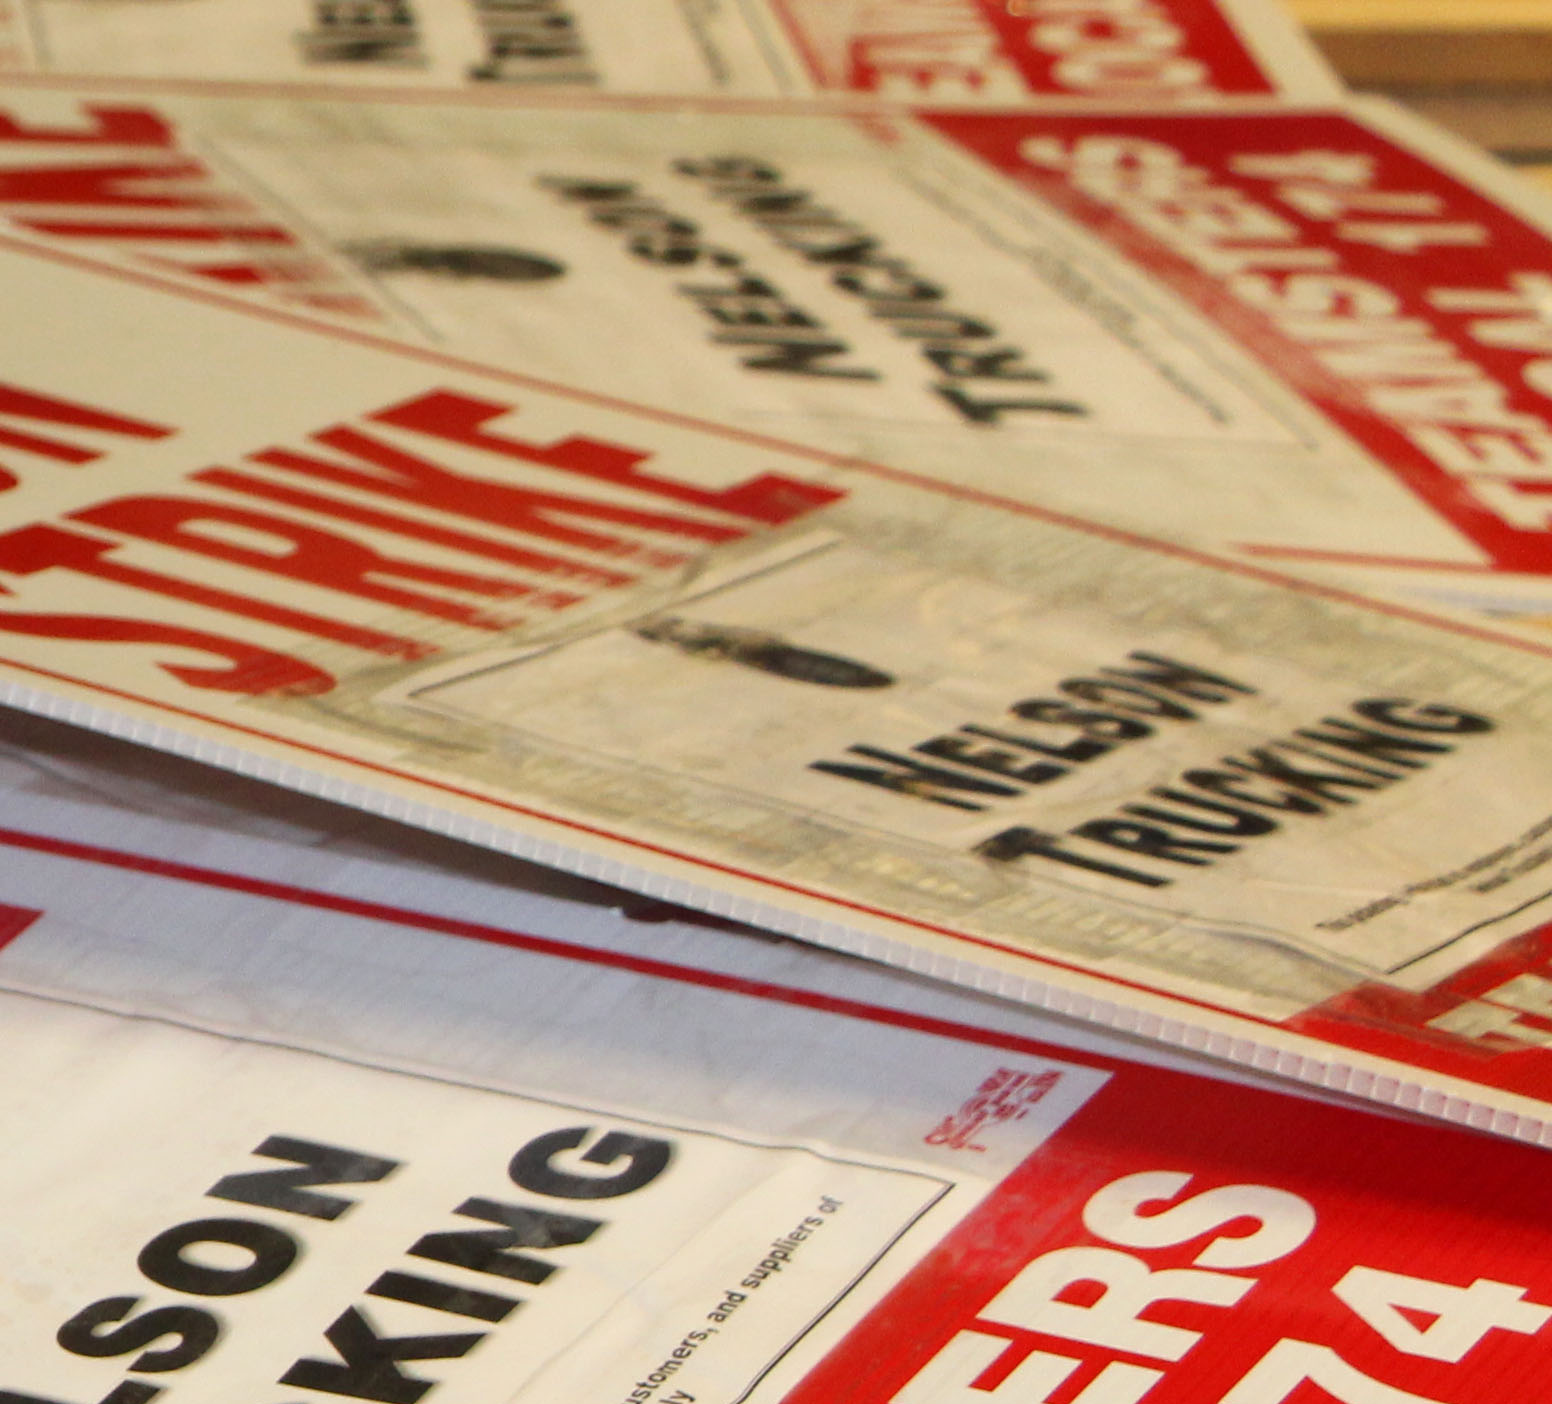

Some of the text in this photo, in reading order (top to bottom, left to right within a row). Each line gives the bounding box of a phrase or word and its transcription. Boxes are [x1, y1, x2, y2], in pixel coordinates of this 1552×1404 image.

[536, 174, 883, 382] NELSON
[672, 155, 1092, 430] TRUCKING
[808, 650, 1260, 812] NELSON
[972, 695, 1498, 888] TRUCKING
[705, 1288, 749, 1325] and
[740, 1215, 825, 1290] suppliers
[816, 1194, 845, 1215] of
